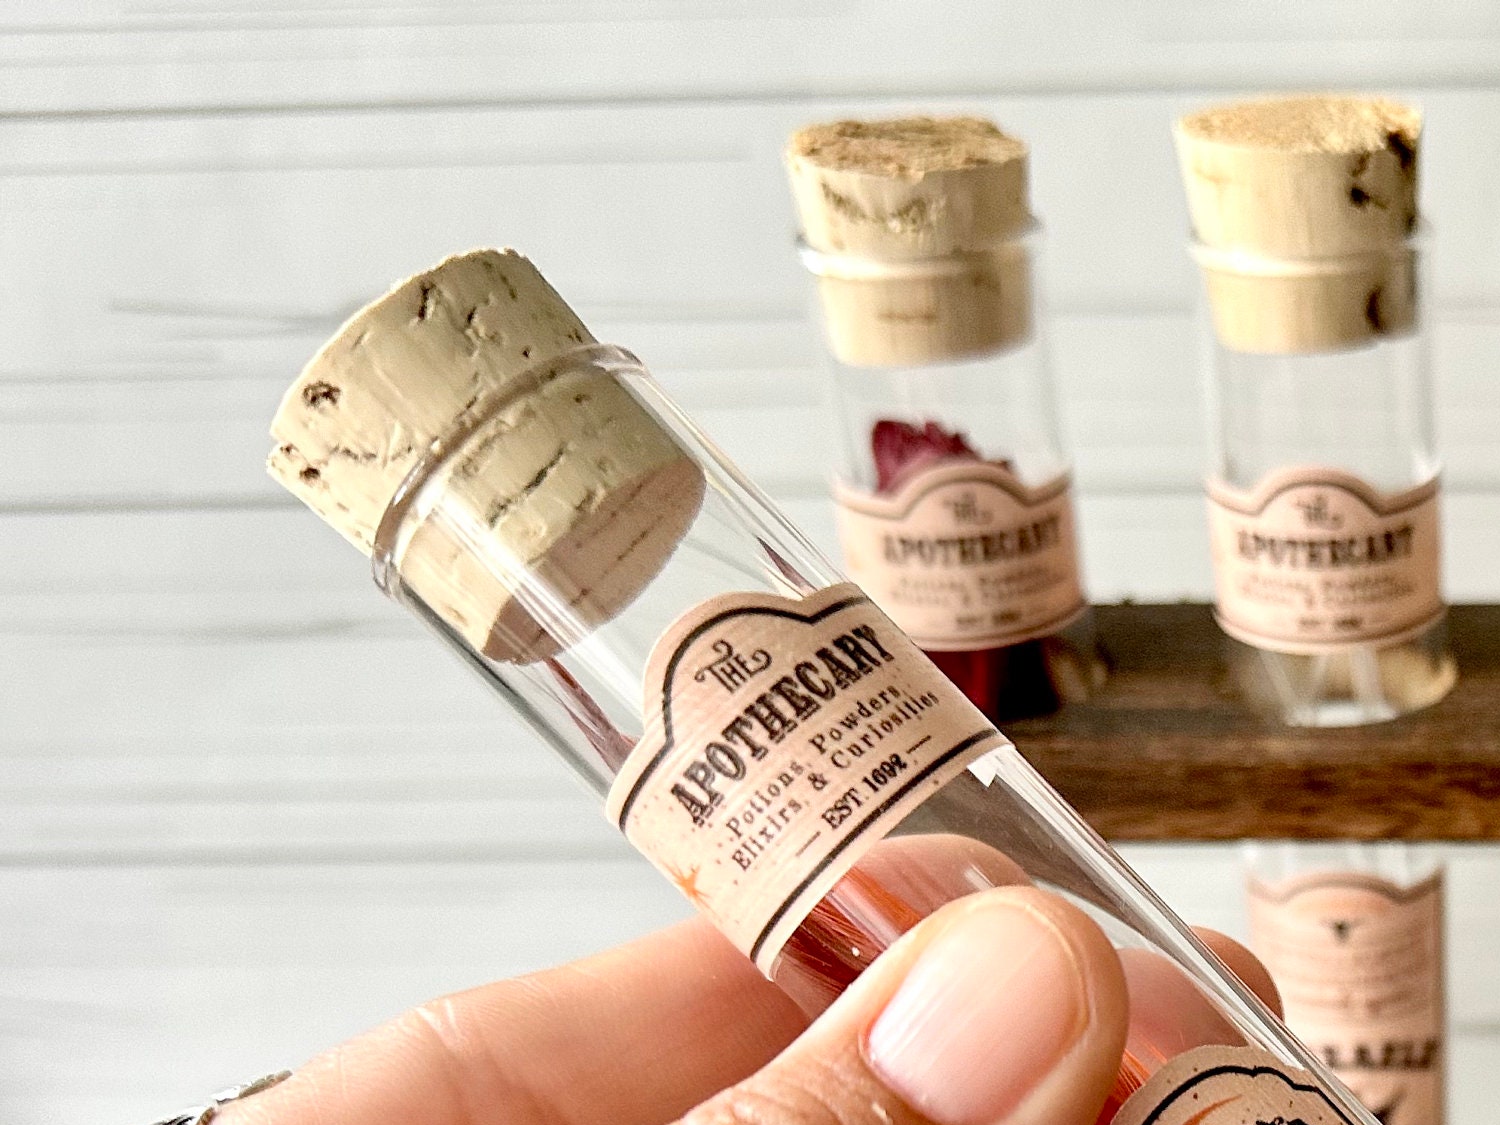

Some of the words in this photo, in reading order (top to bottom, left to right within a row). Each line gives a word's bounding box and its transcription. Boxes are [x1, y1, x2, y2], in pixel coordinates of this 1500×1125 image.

[695, 638, 771, 694] THE
[671, 624, 894, 827] APOTHECARY
[807, 771, 829, 791] &
[831, 690, 939, 768] Curiosities
[862, 753, 907, 792] 1692
